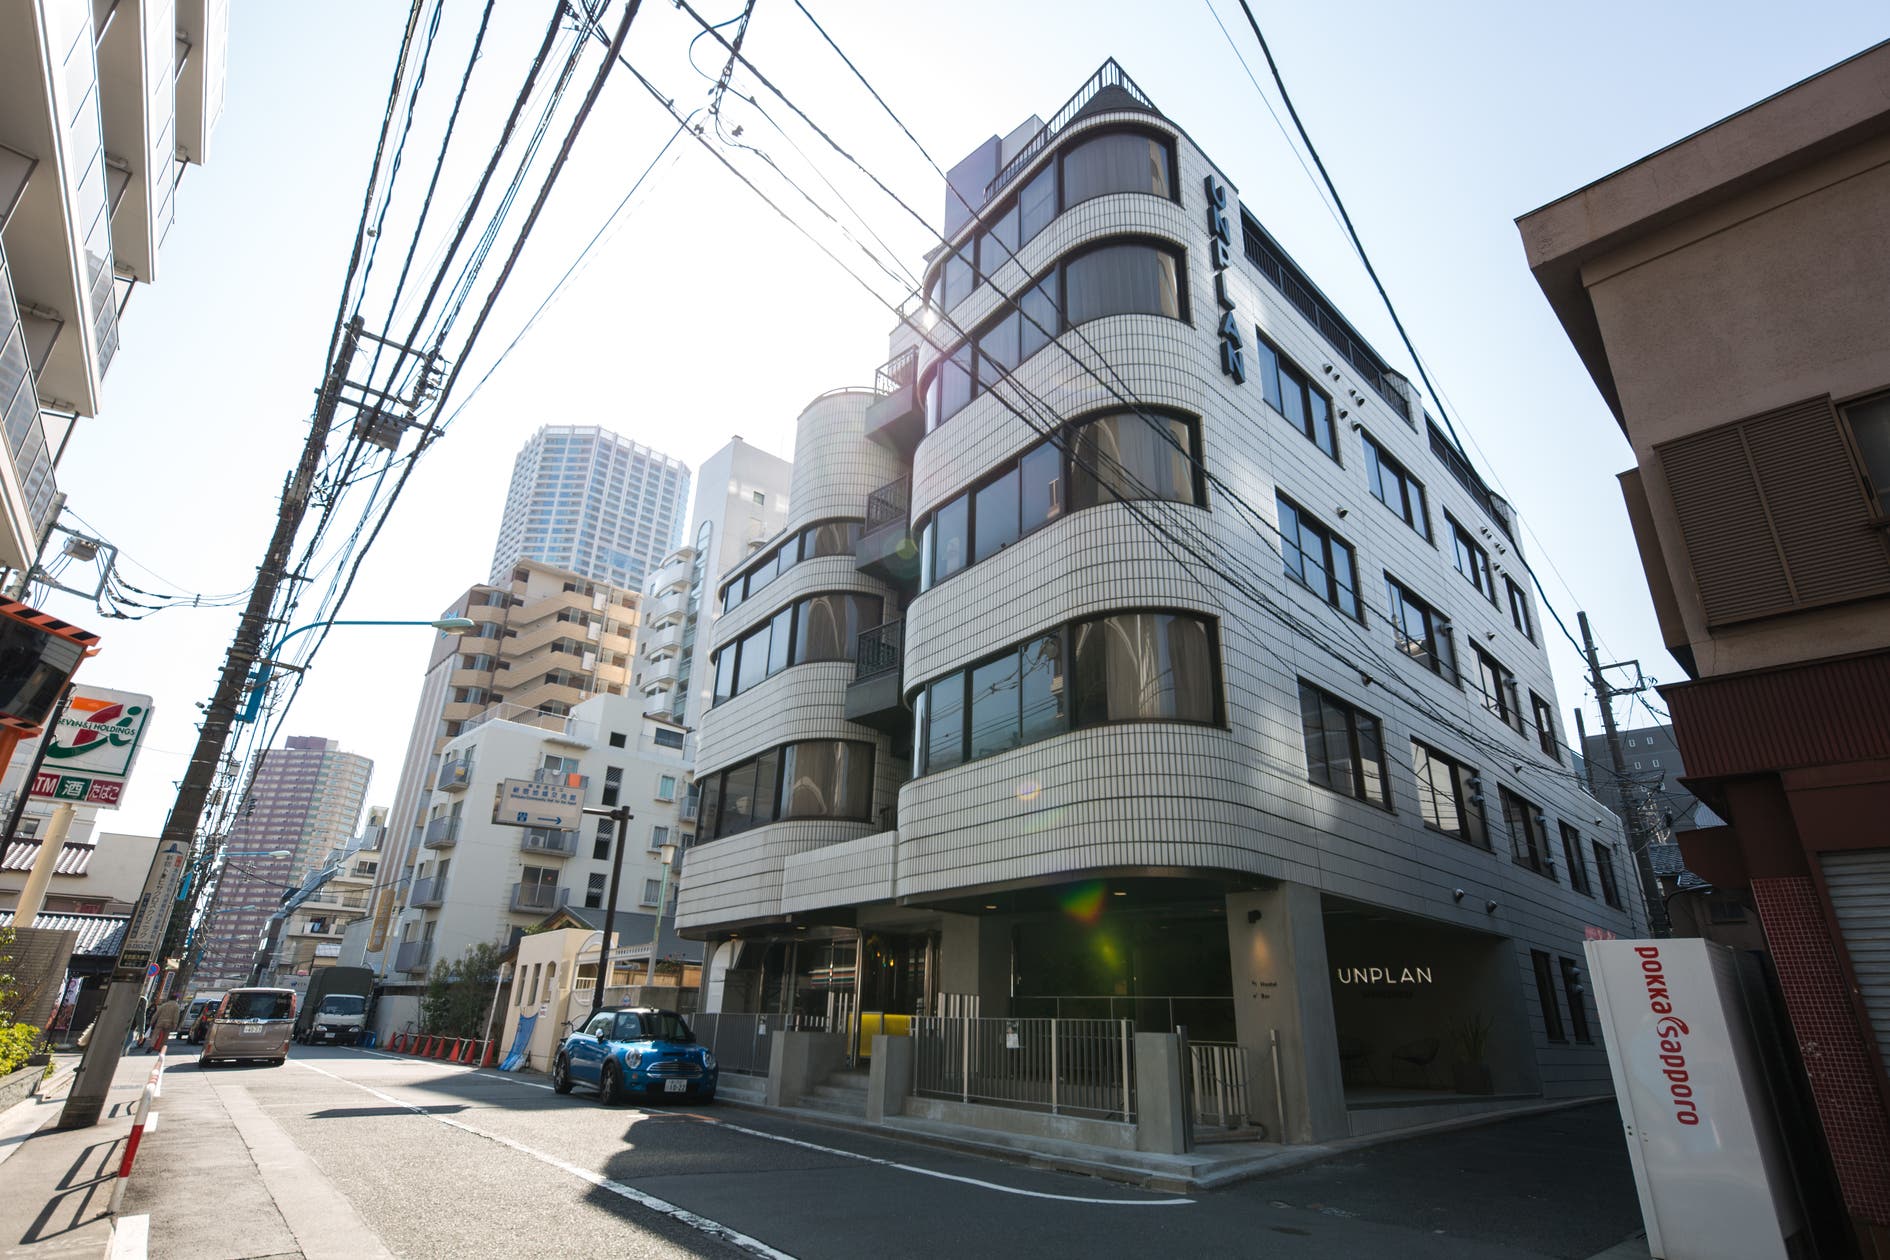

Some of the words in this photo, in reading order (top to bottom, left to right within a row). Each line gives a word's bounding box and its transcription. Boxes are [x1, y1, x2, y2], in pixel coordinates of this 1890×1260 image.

[1204, 174, 1245, 385] UNPLAN
[93, 723, 136, 736] HOLDINGS
[62, 780, 85, 796] 酒
[89, 783, 120, 800] たばこ
[1337, 967, 1432, 984] UNPLAN
